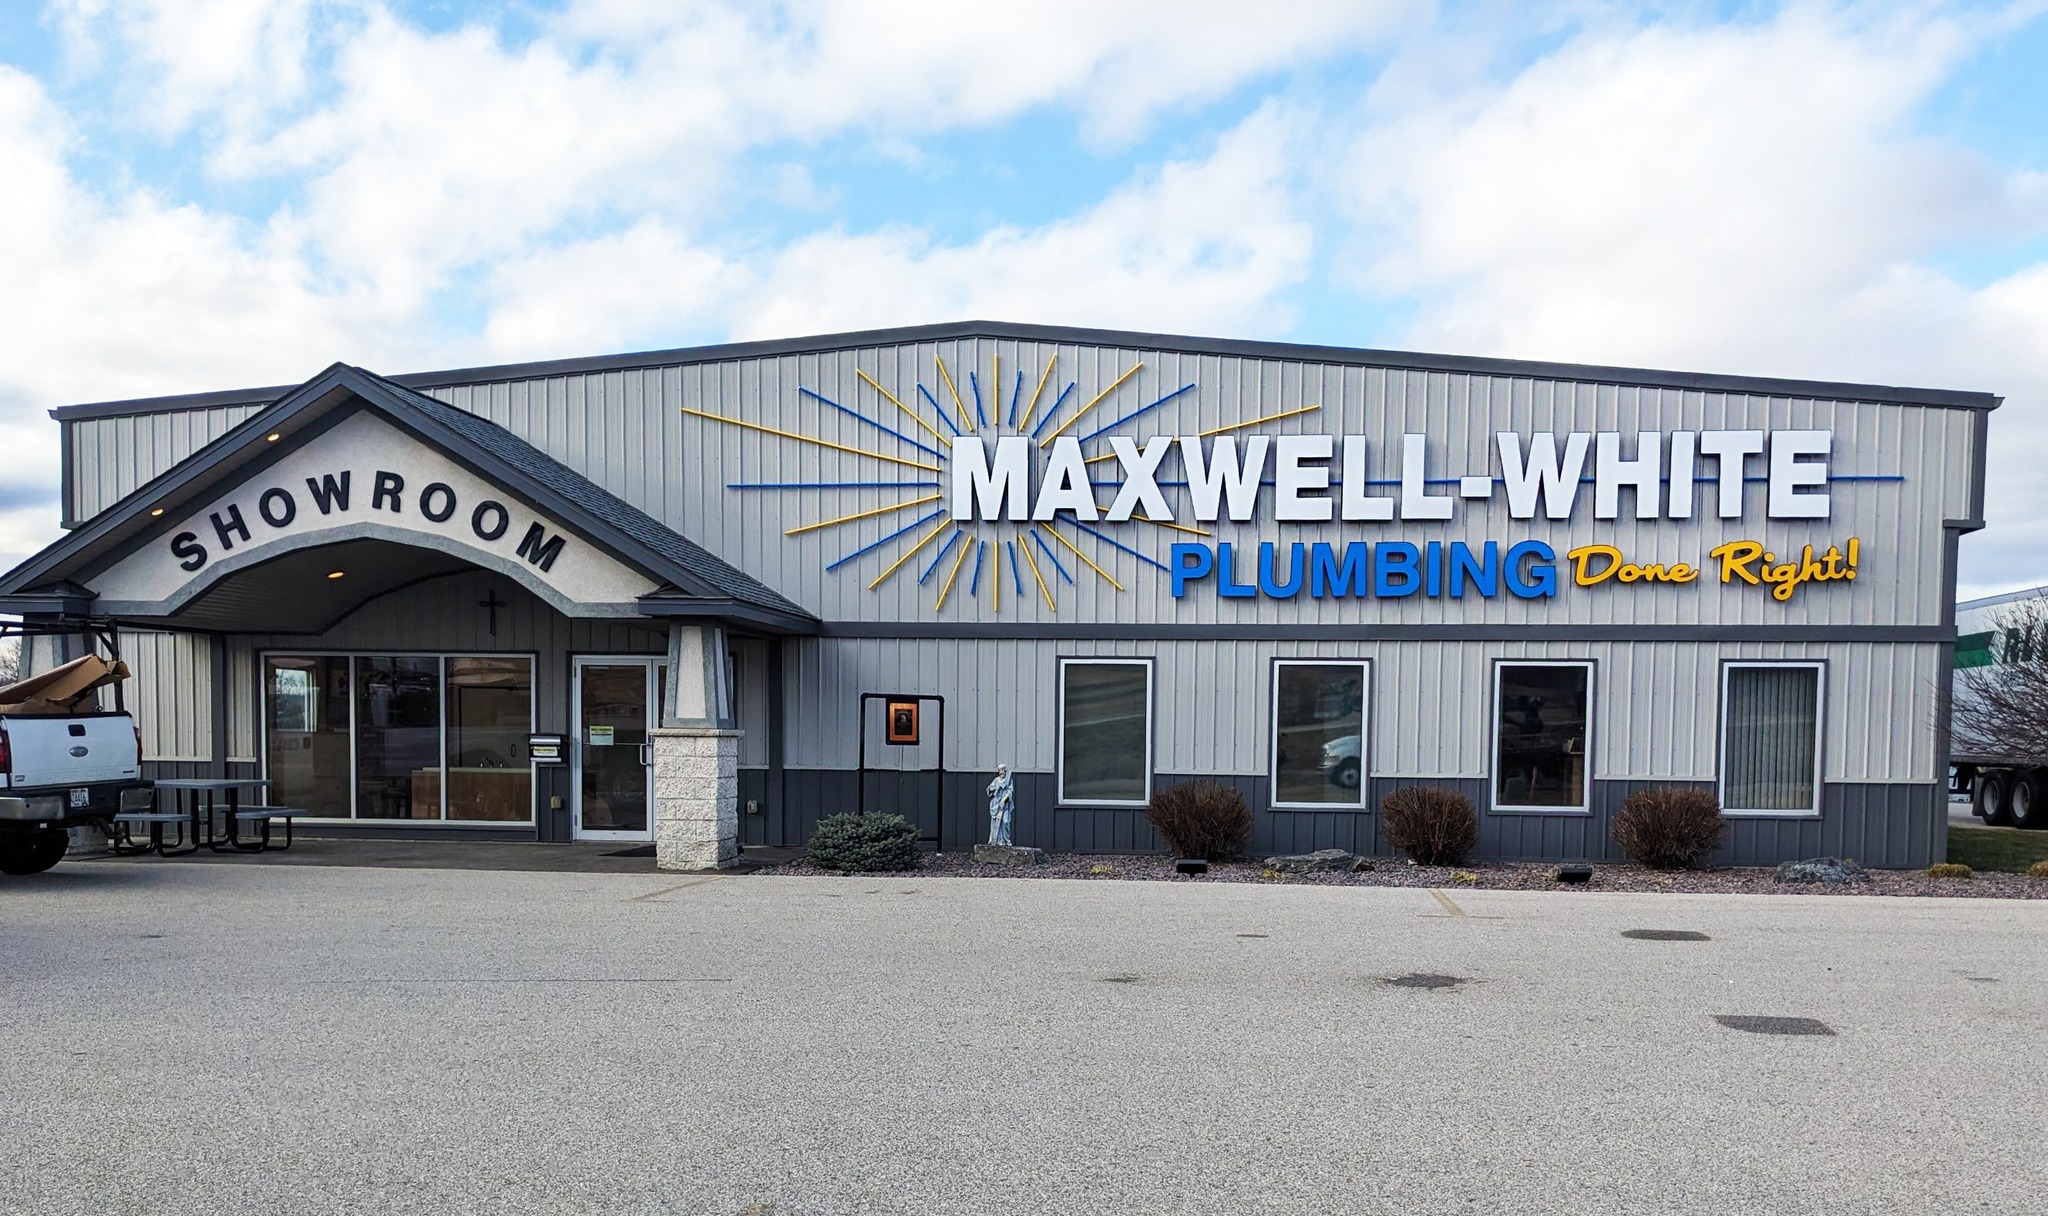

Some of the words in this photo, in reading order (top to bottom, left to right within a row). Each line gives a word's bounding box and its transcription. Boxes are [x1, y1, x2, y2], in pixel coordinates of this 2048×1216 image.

[170, 469, 567, 573] SHOWROOM
[951, 429, 1832, 522] MAXWELL-WHITE
[1171, 540, 1558, 600] PLUMBING
[1567, 543, 1699, 587] Done
[1709, 537, 1860, 601] Right!
